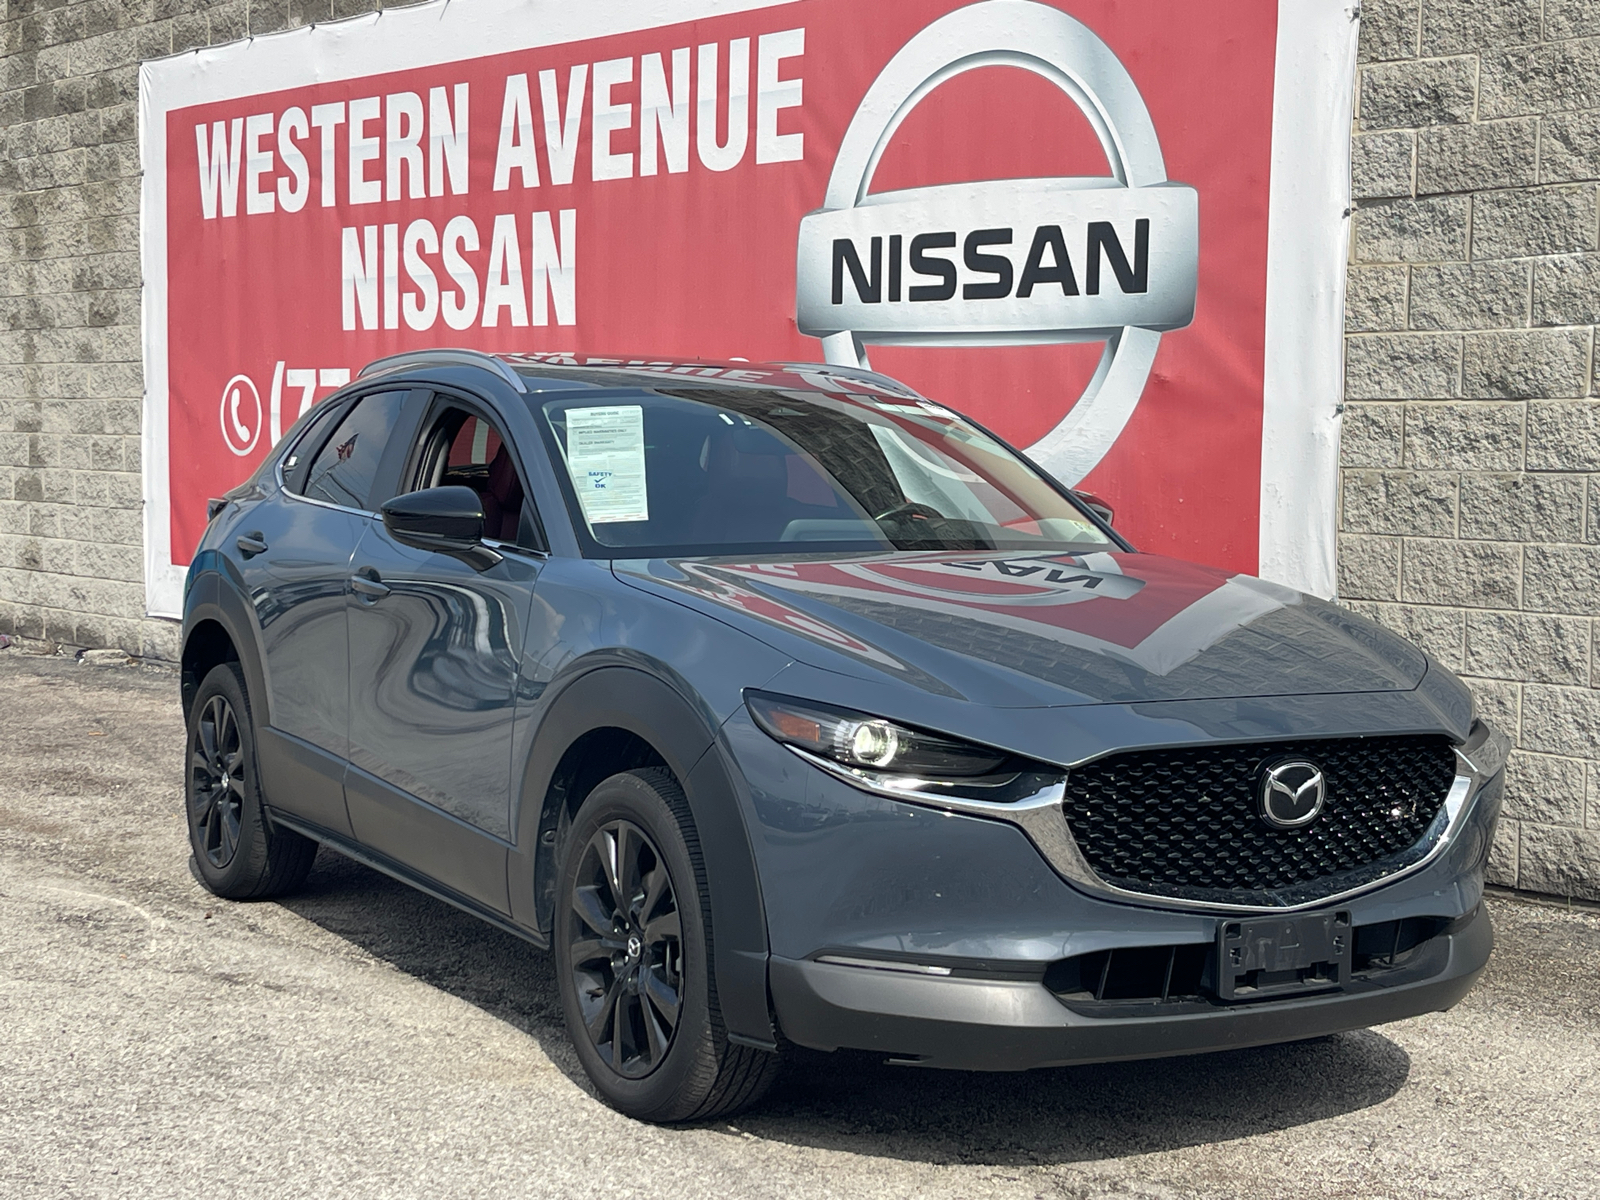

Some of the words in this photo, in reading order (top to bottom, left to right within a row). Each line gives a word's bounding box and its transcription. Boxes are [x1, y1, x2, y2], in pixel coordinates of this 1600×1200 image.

[196, 82, 470, 220] WESTERN
[493, 28, 806, 191] AVENUE
[342, 208, 577, 331] NISSAN
[832, 218, 1150, 305] NISSAN
